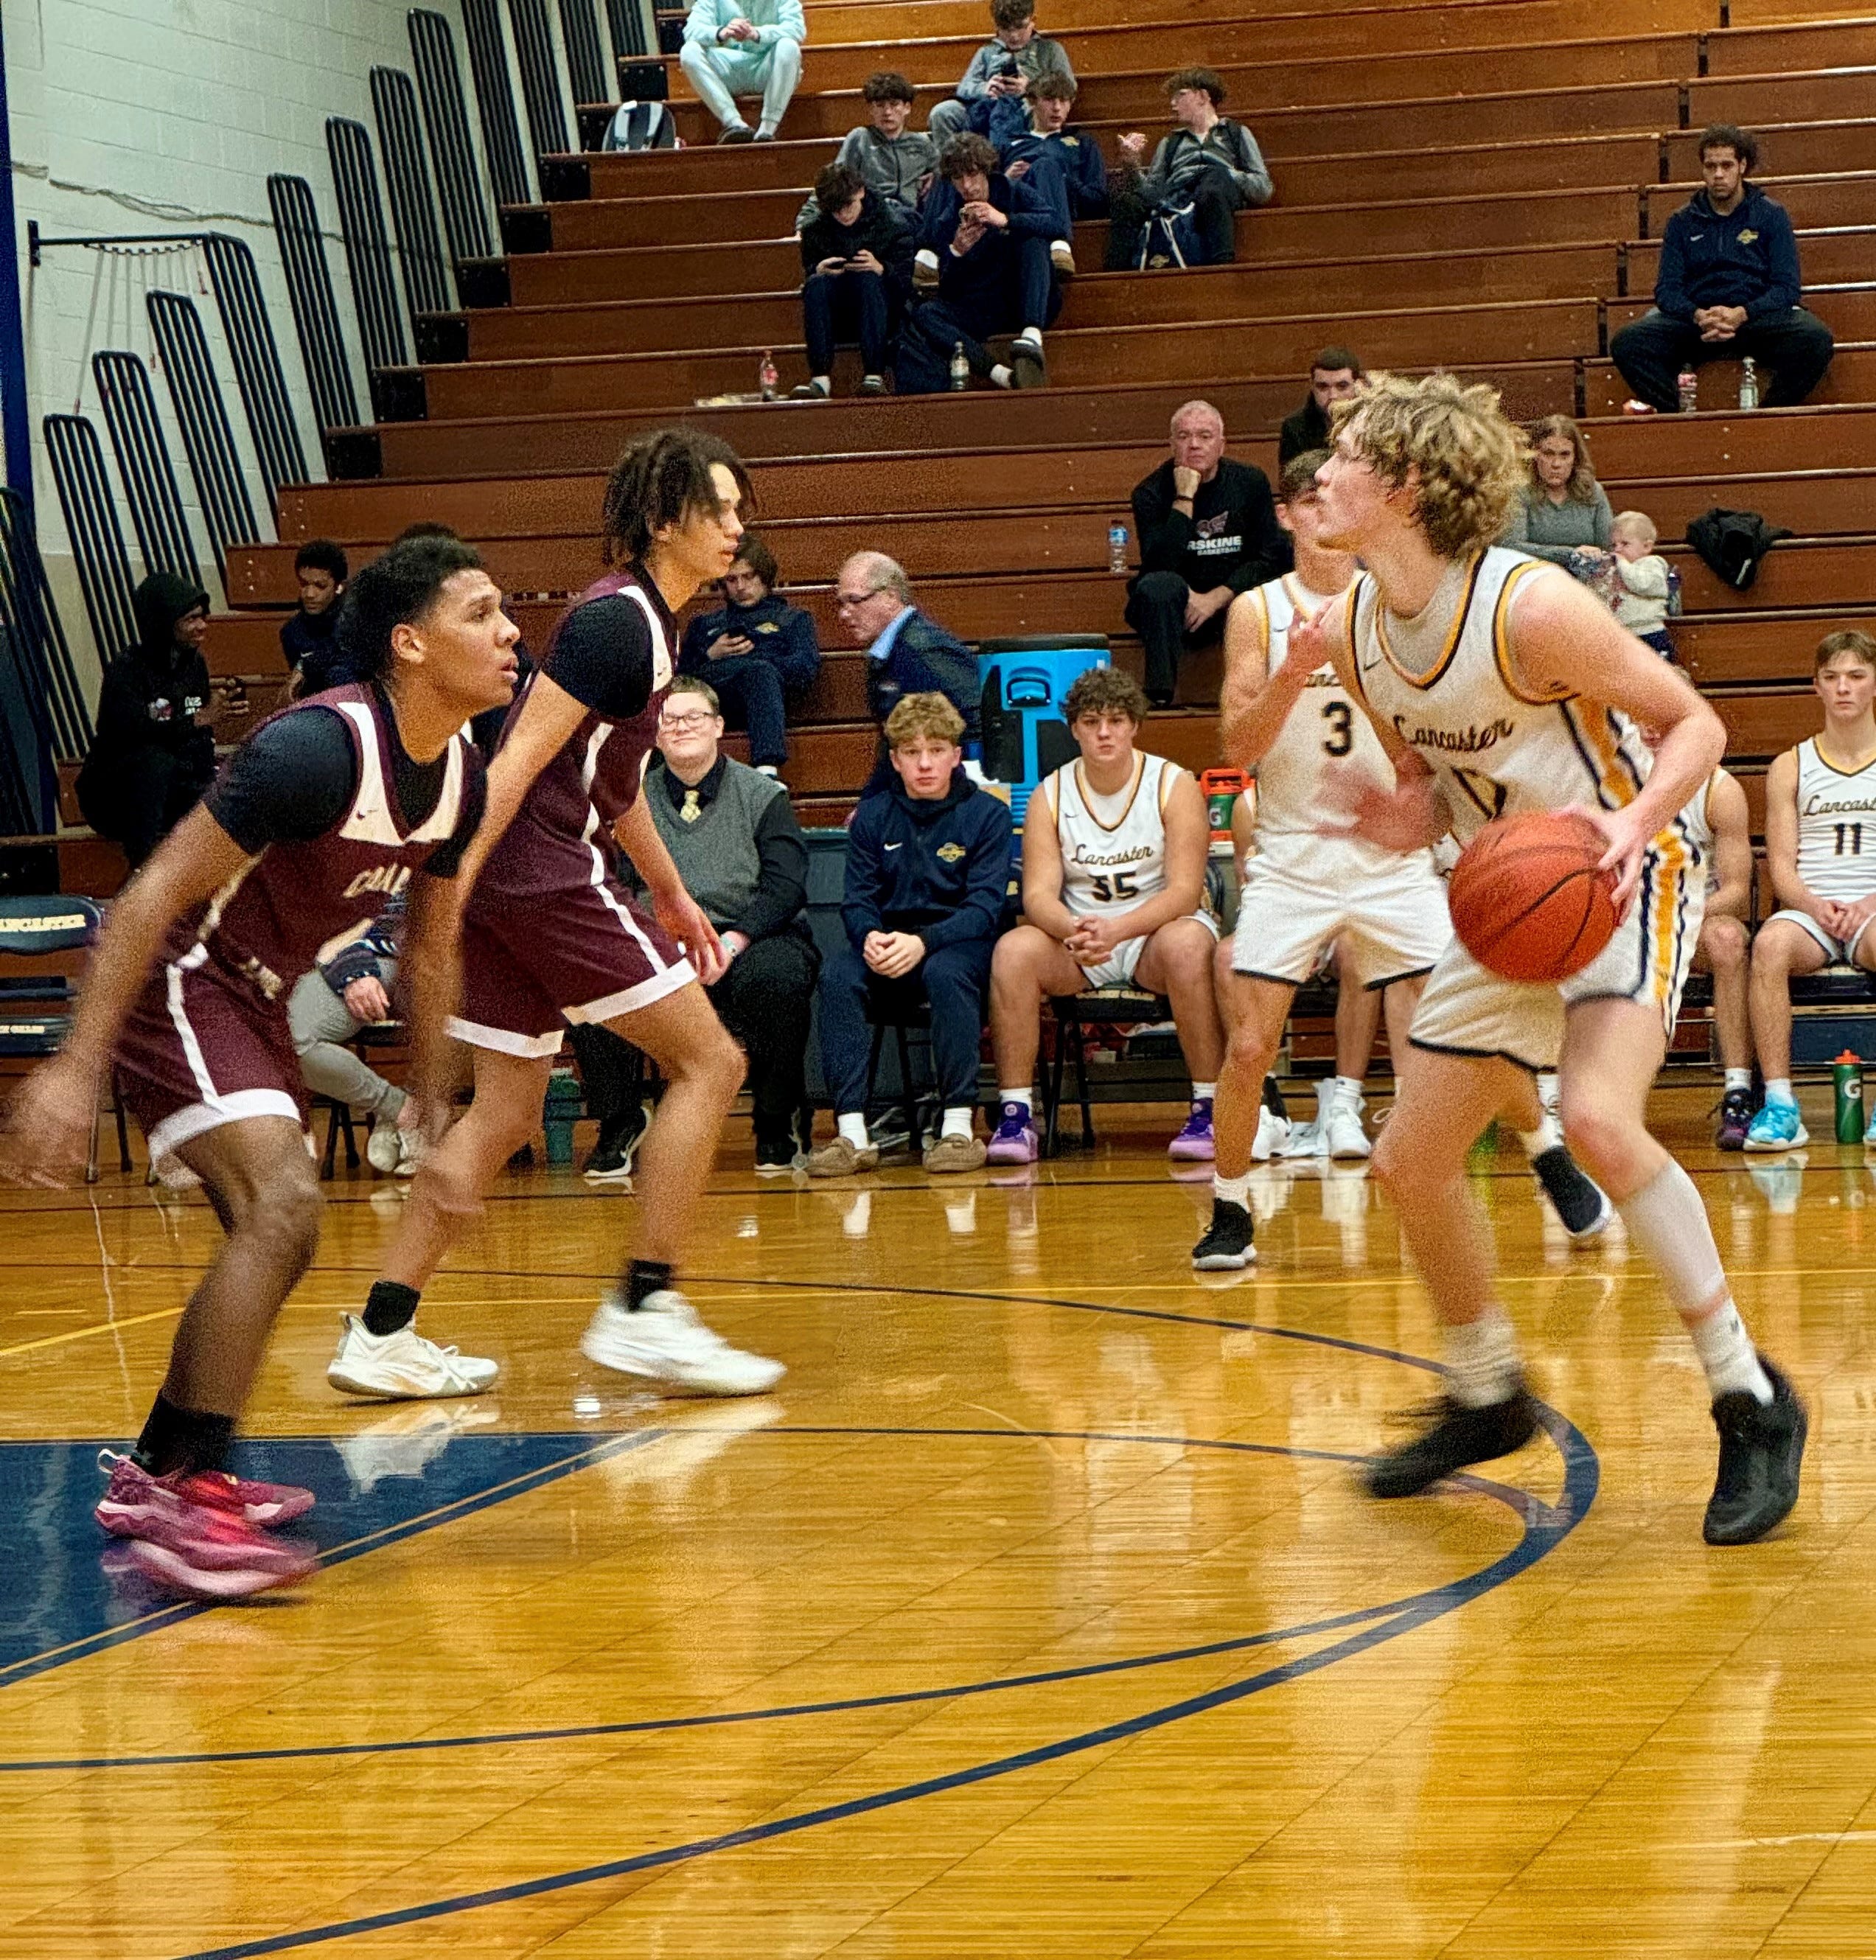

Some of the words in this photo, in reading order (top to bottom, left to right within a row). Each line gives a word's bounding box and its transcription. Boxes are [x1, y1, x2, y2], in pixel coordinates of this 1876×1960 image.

[1322, 702, 1352, 757] 3
[1210, 807, 1222, 826] G
[1834, 822, 1863, 856] 11
[1071, 843, 1154, 866] Lancaster
[1844, 1078, 1862, 1099] G
